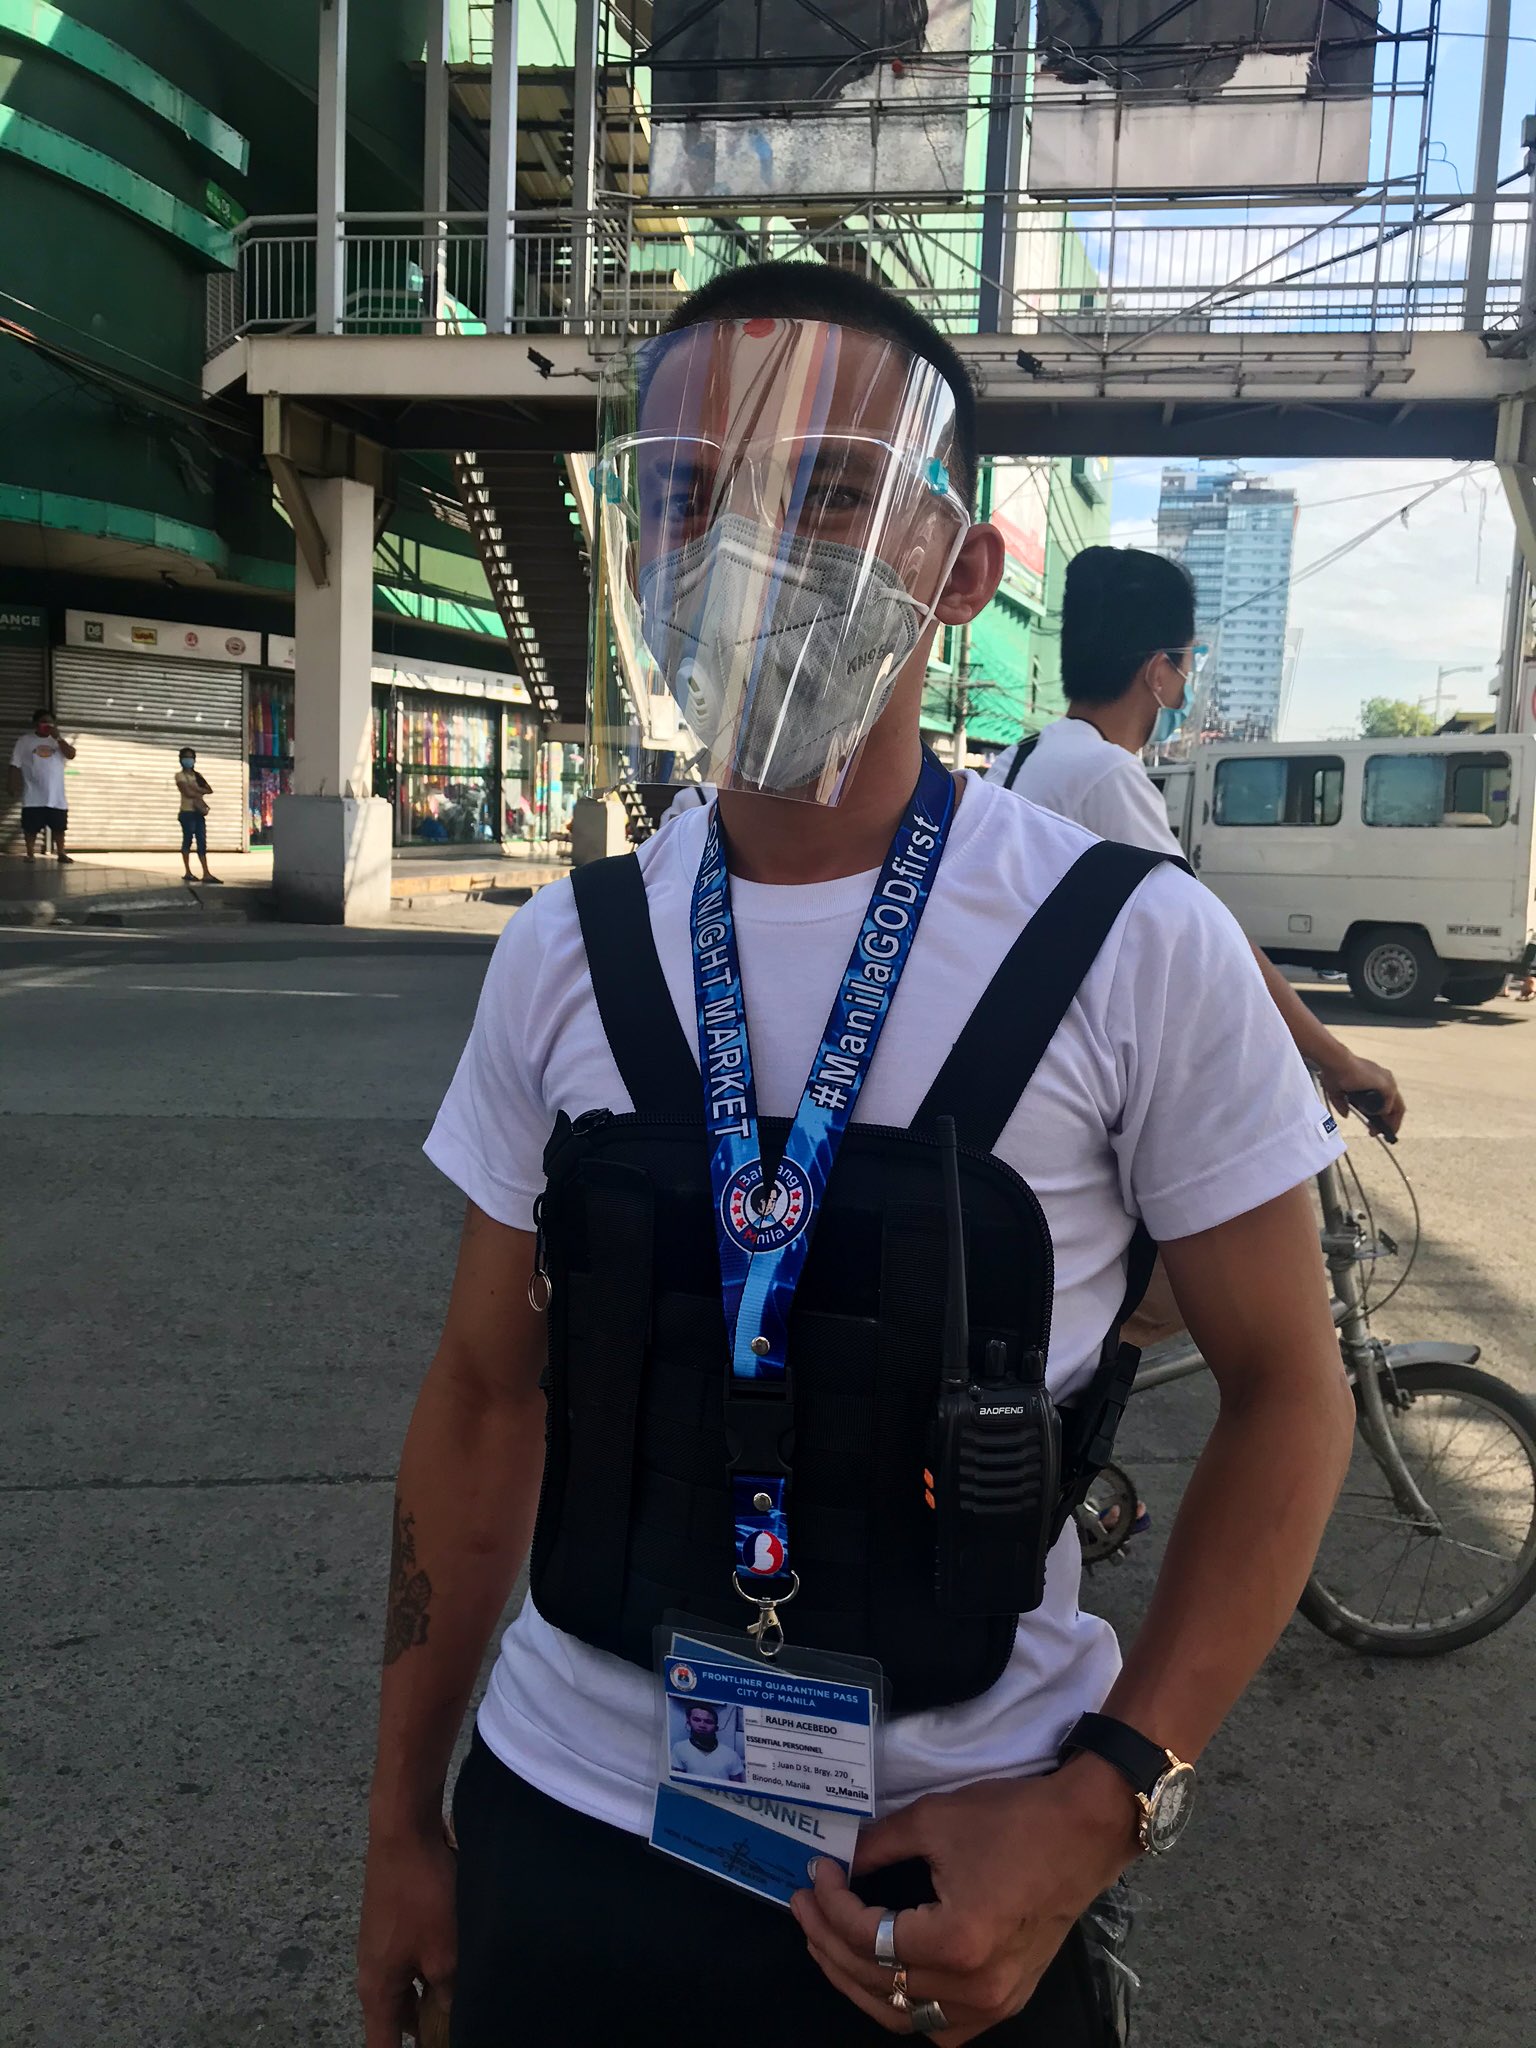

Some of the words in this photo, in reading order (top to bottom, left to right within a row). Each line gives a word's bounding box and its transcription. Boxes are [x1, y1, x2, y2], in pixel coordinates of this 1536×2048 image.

[846, 644, 887, 675] KN95
[697, 889, 732, 987] NIGHT
[809, 814, 940, 1110] #ManilaGODfirst
[704, 999, 749, 1138] MARKET
[980, 1406, 1024, 1416] BAOFENG
[702, 1671, 762, 1687] FRONTLINER
[765, 1681, 830, 1699] QUARANTINE
[833, 1692, 858, 1704] PASS
[736, 1687, 759, 1698] CITY
[761, 1691, 775, 1701] OF
[778, 1694, 816, 1707] MANILA
[766, 1715, 794, 1729] RALPH
[796, 1721, 838, 1735] ACEBEDO
[746, 1735, 782, 1747] ESSENTIAL
[782, 1741, 823, 1754] PERSONNEL
[777, 1761, 794, 1770] Juan
[834, 1770, 849, 1779] 270
[785, 1779, 810, 1790] Manila
